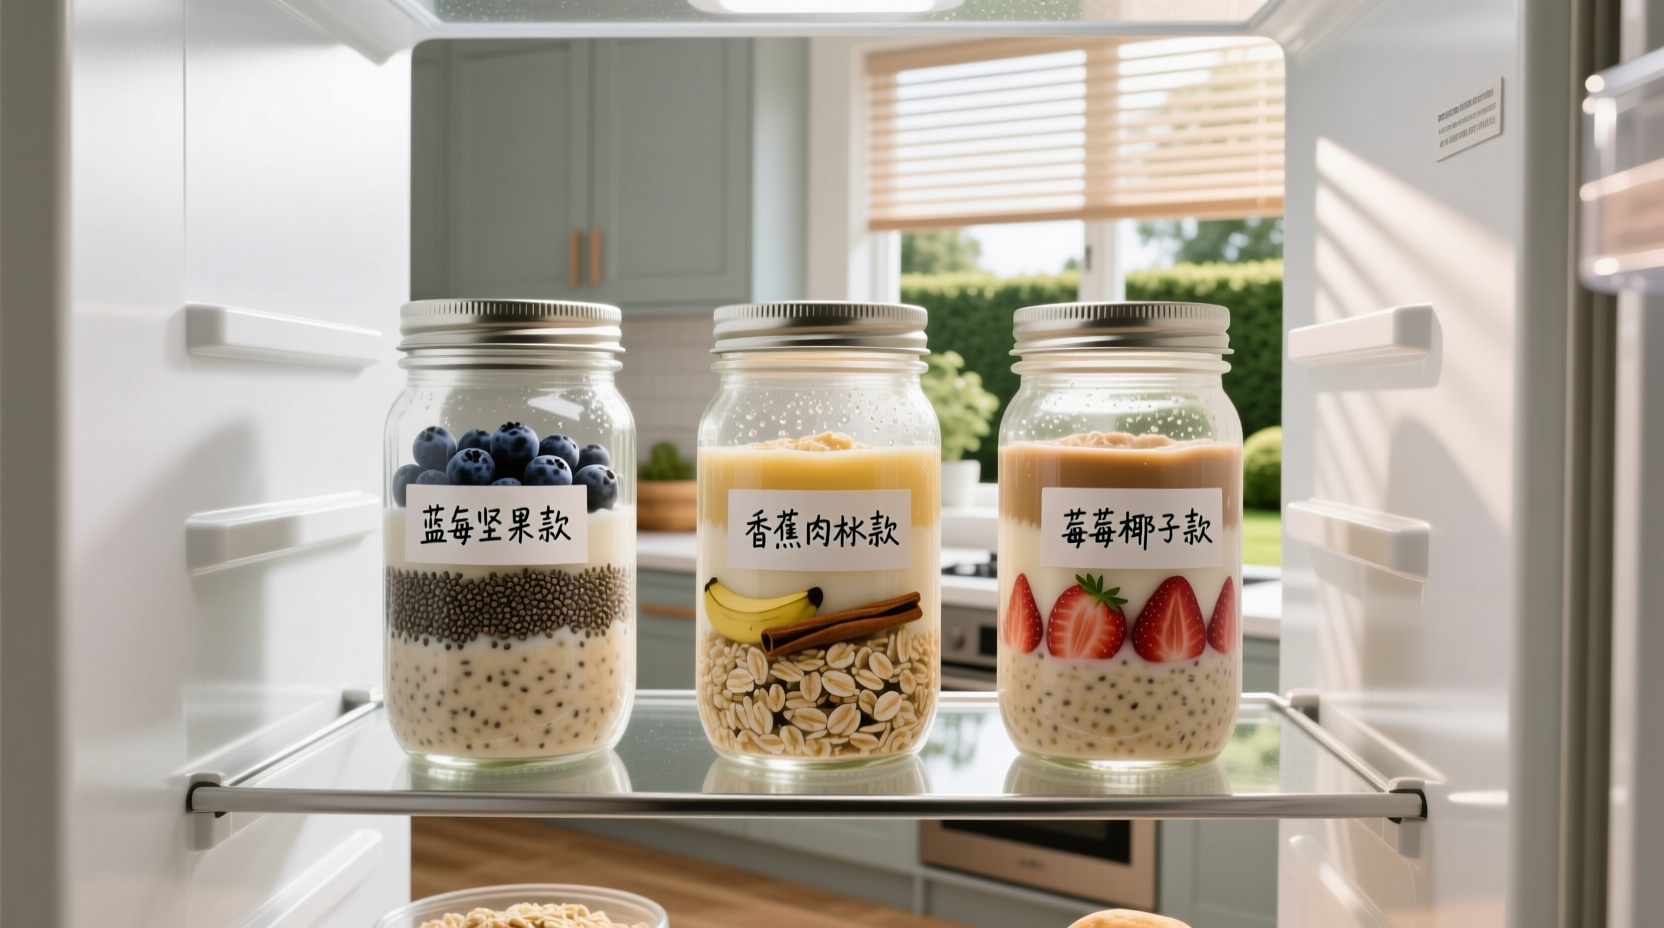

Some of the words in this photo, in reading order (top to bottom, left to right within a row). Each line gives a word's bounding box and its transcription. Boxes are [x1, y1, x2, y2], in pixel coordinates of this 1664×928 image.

[1061, 507, 1213, 550] 莓莓椰子款
